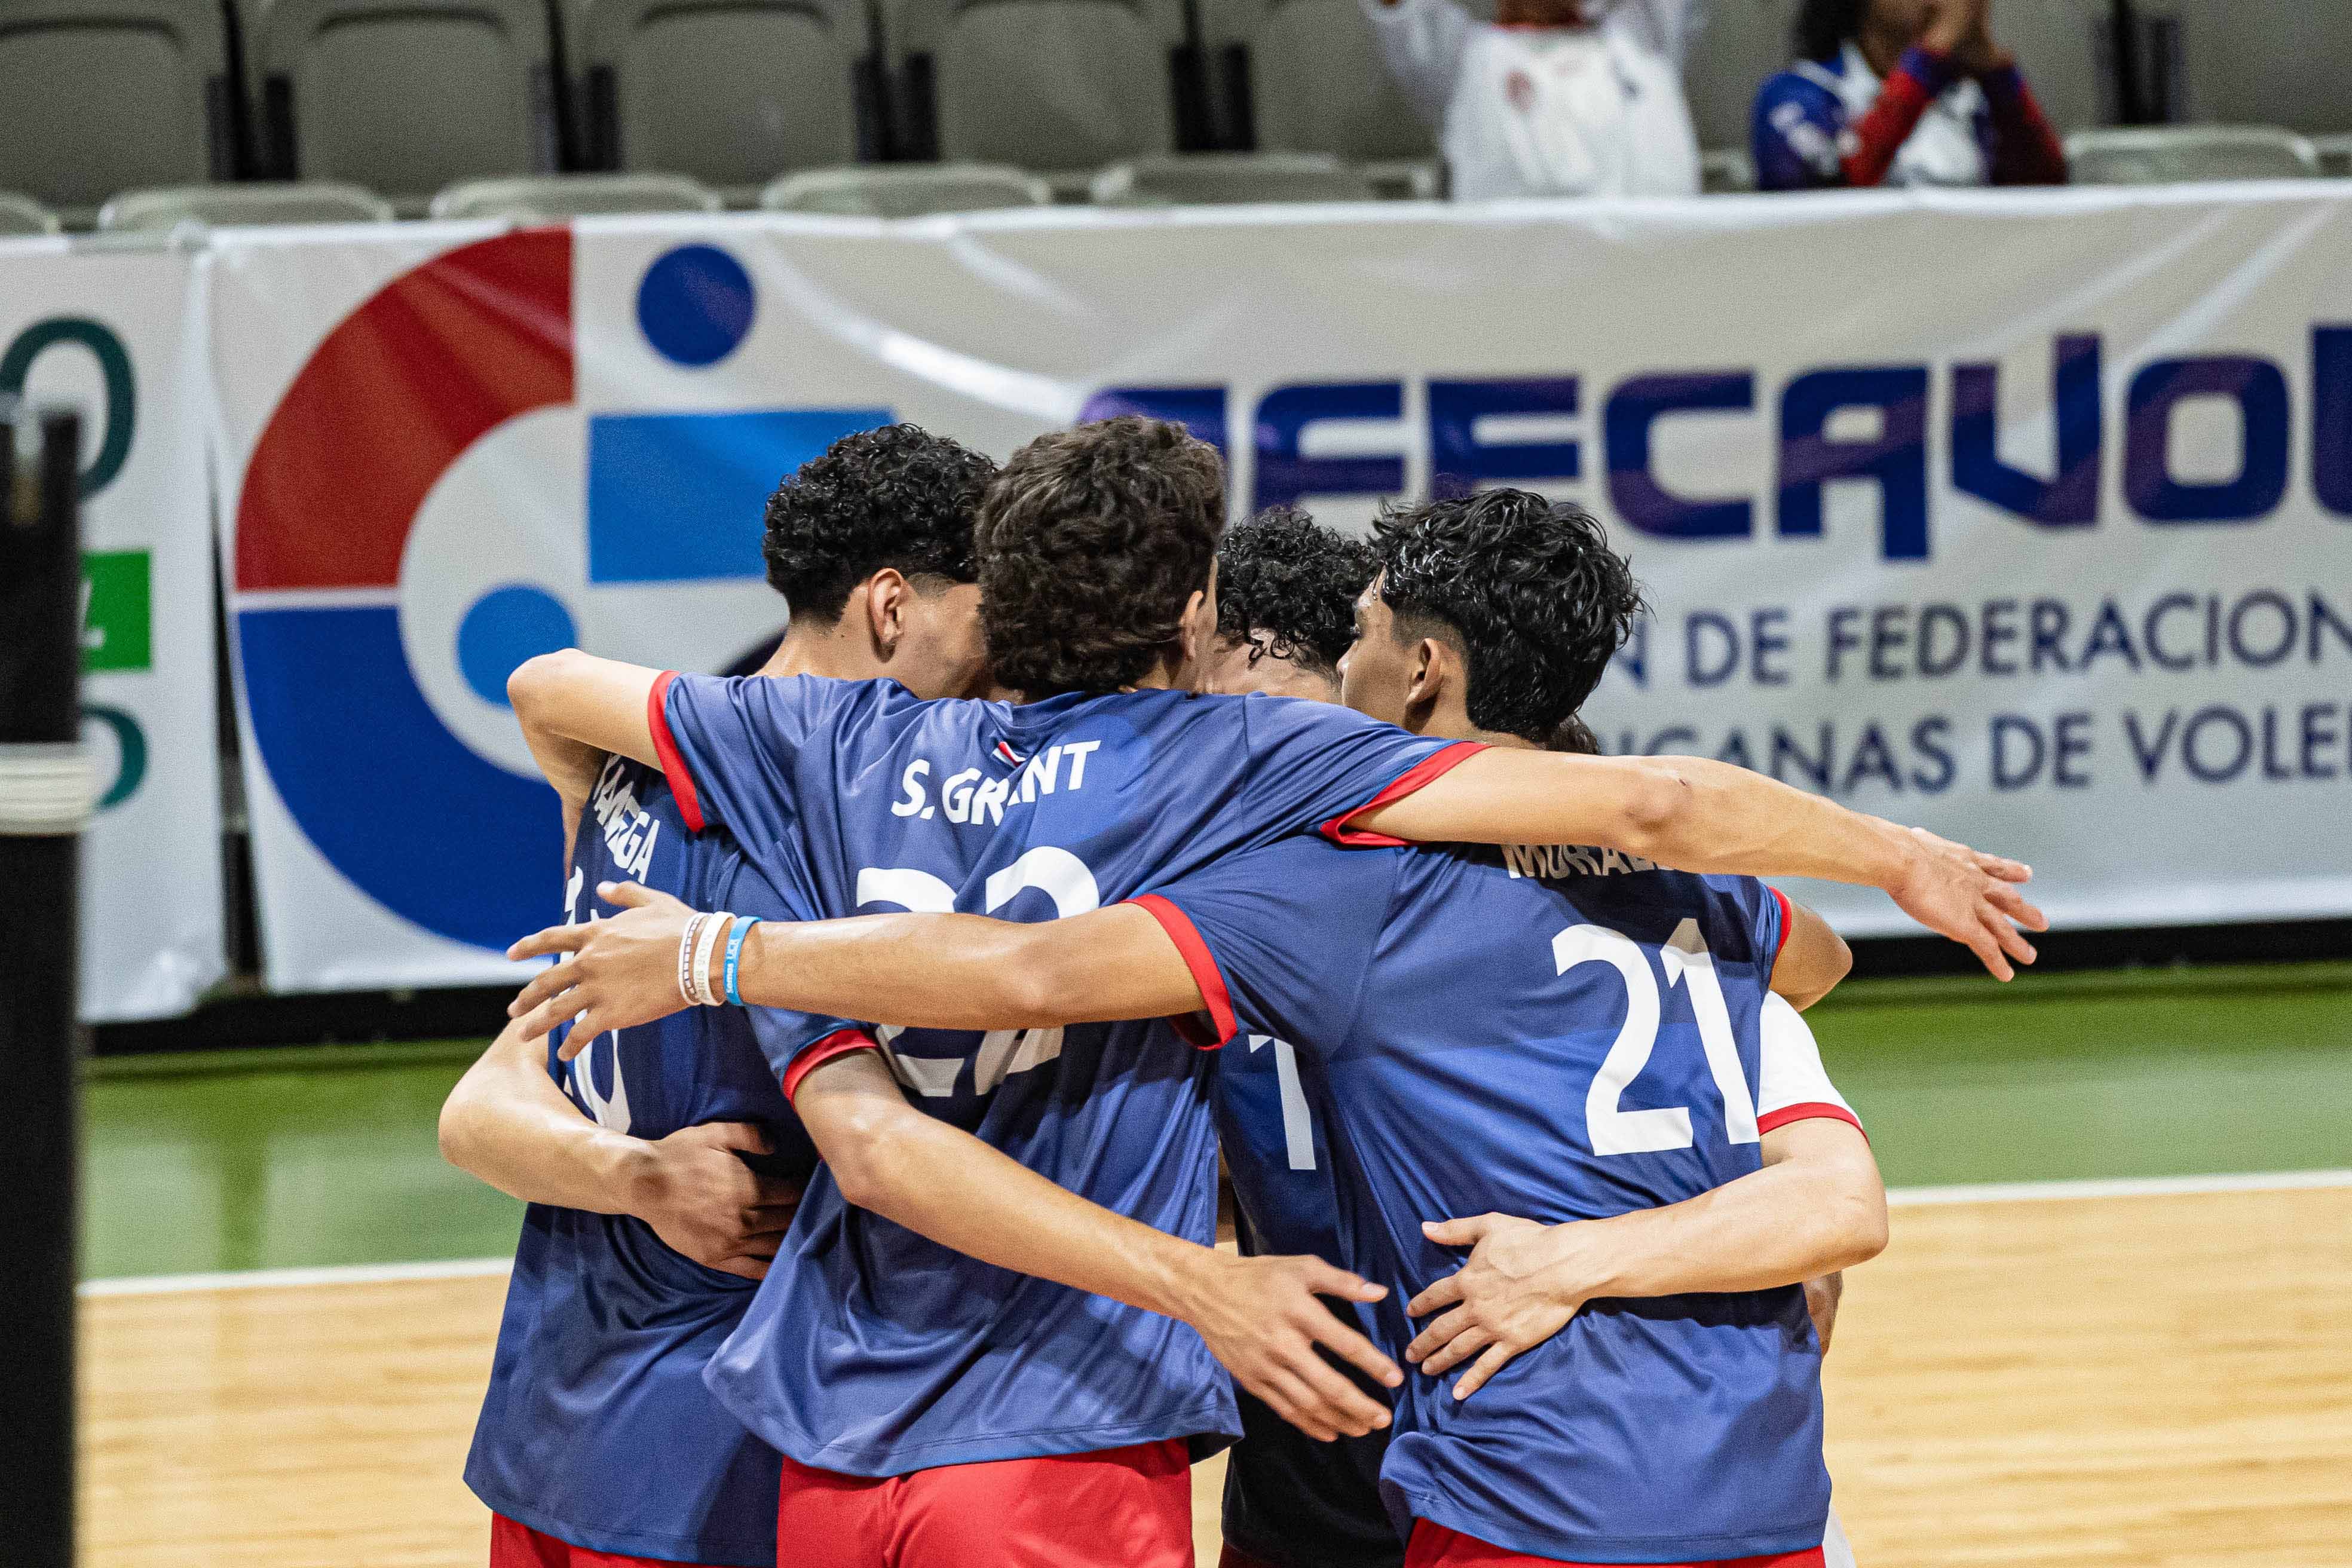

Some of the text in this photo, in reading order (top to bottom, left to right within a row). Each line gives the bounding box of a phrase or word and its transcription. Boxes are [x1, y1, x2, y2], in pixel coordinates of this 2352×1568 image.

[1077, 324, 2352, 561] FECAVO
[1685, 608, 1790, 687] DE
[890, 740, 1101, 826] S.GRNT
[1992, 711, 2093, 792] DE
[2124, 702, 2352, 784] VOLE
[1552, 917, 1760, 1157] 21
